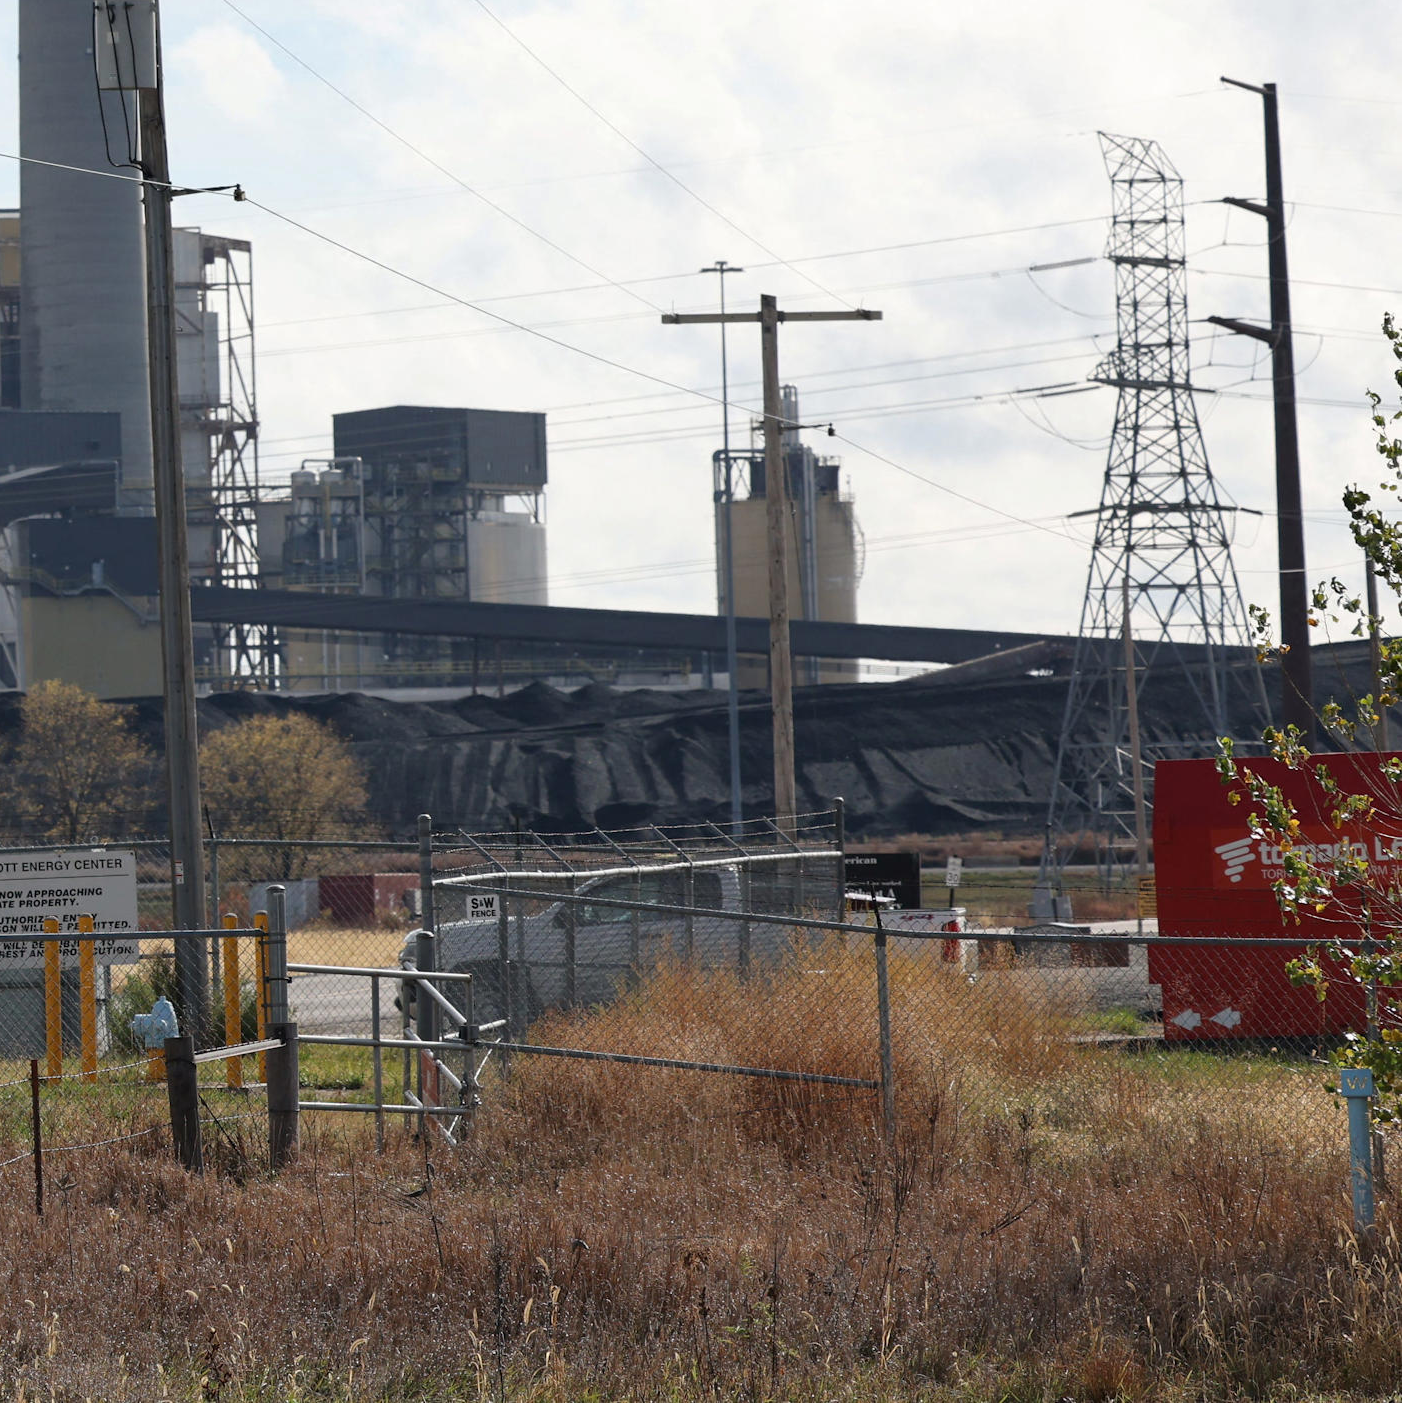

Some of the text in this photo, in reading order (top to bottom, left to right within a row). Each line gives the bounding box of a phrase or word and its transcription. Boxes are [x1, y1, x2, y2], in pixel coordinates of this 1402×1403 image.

[22, 860, 71, 872] ENERGY
[74, 858, 122, 870] CENTER
[27, 887, 103, 898] APPROACHING
[19, 898, 79, 908] PROPERTY.
[62, 913, 98, 923] ENY
[471, 910, 496, 918] FENCE
[67, 920, 131, 931] PEITTED.
